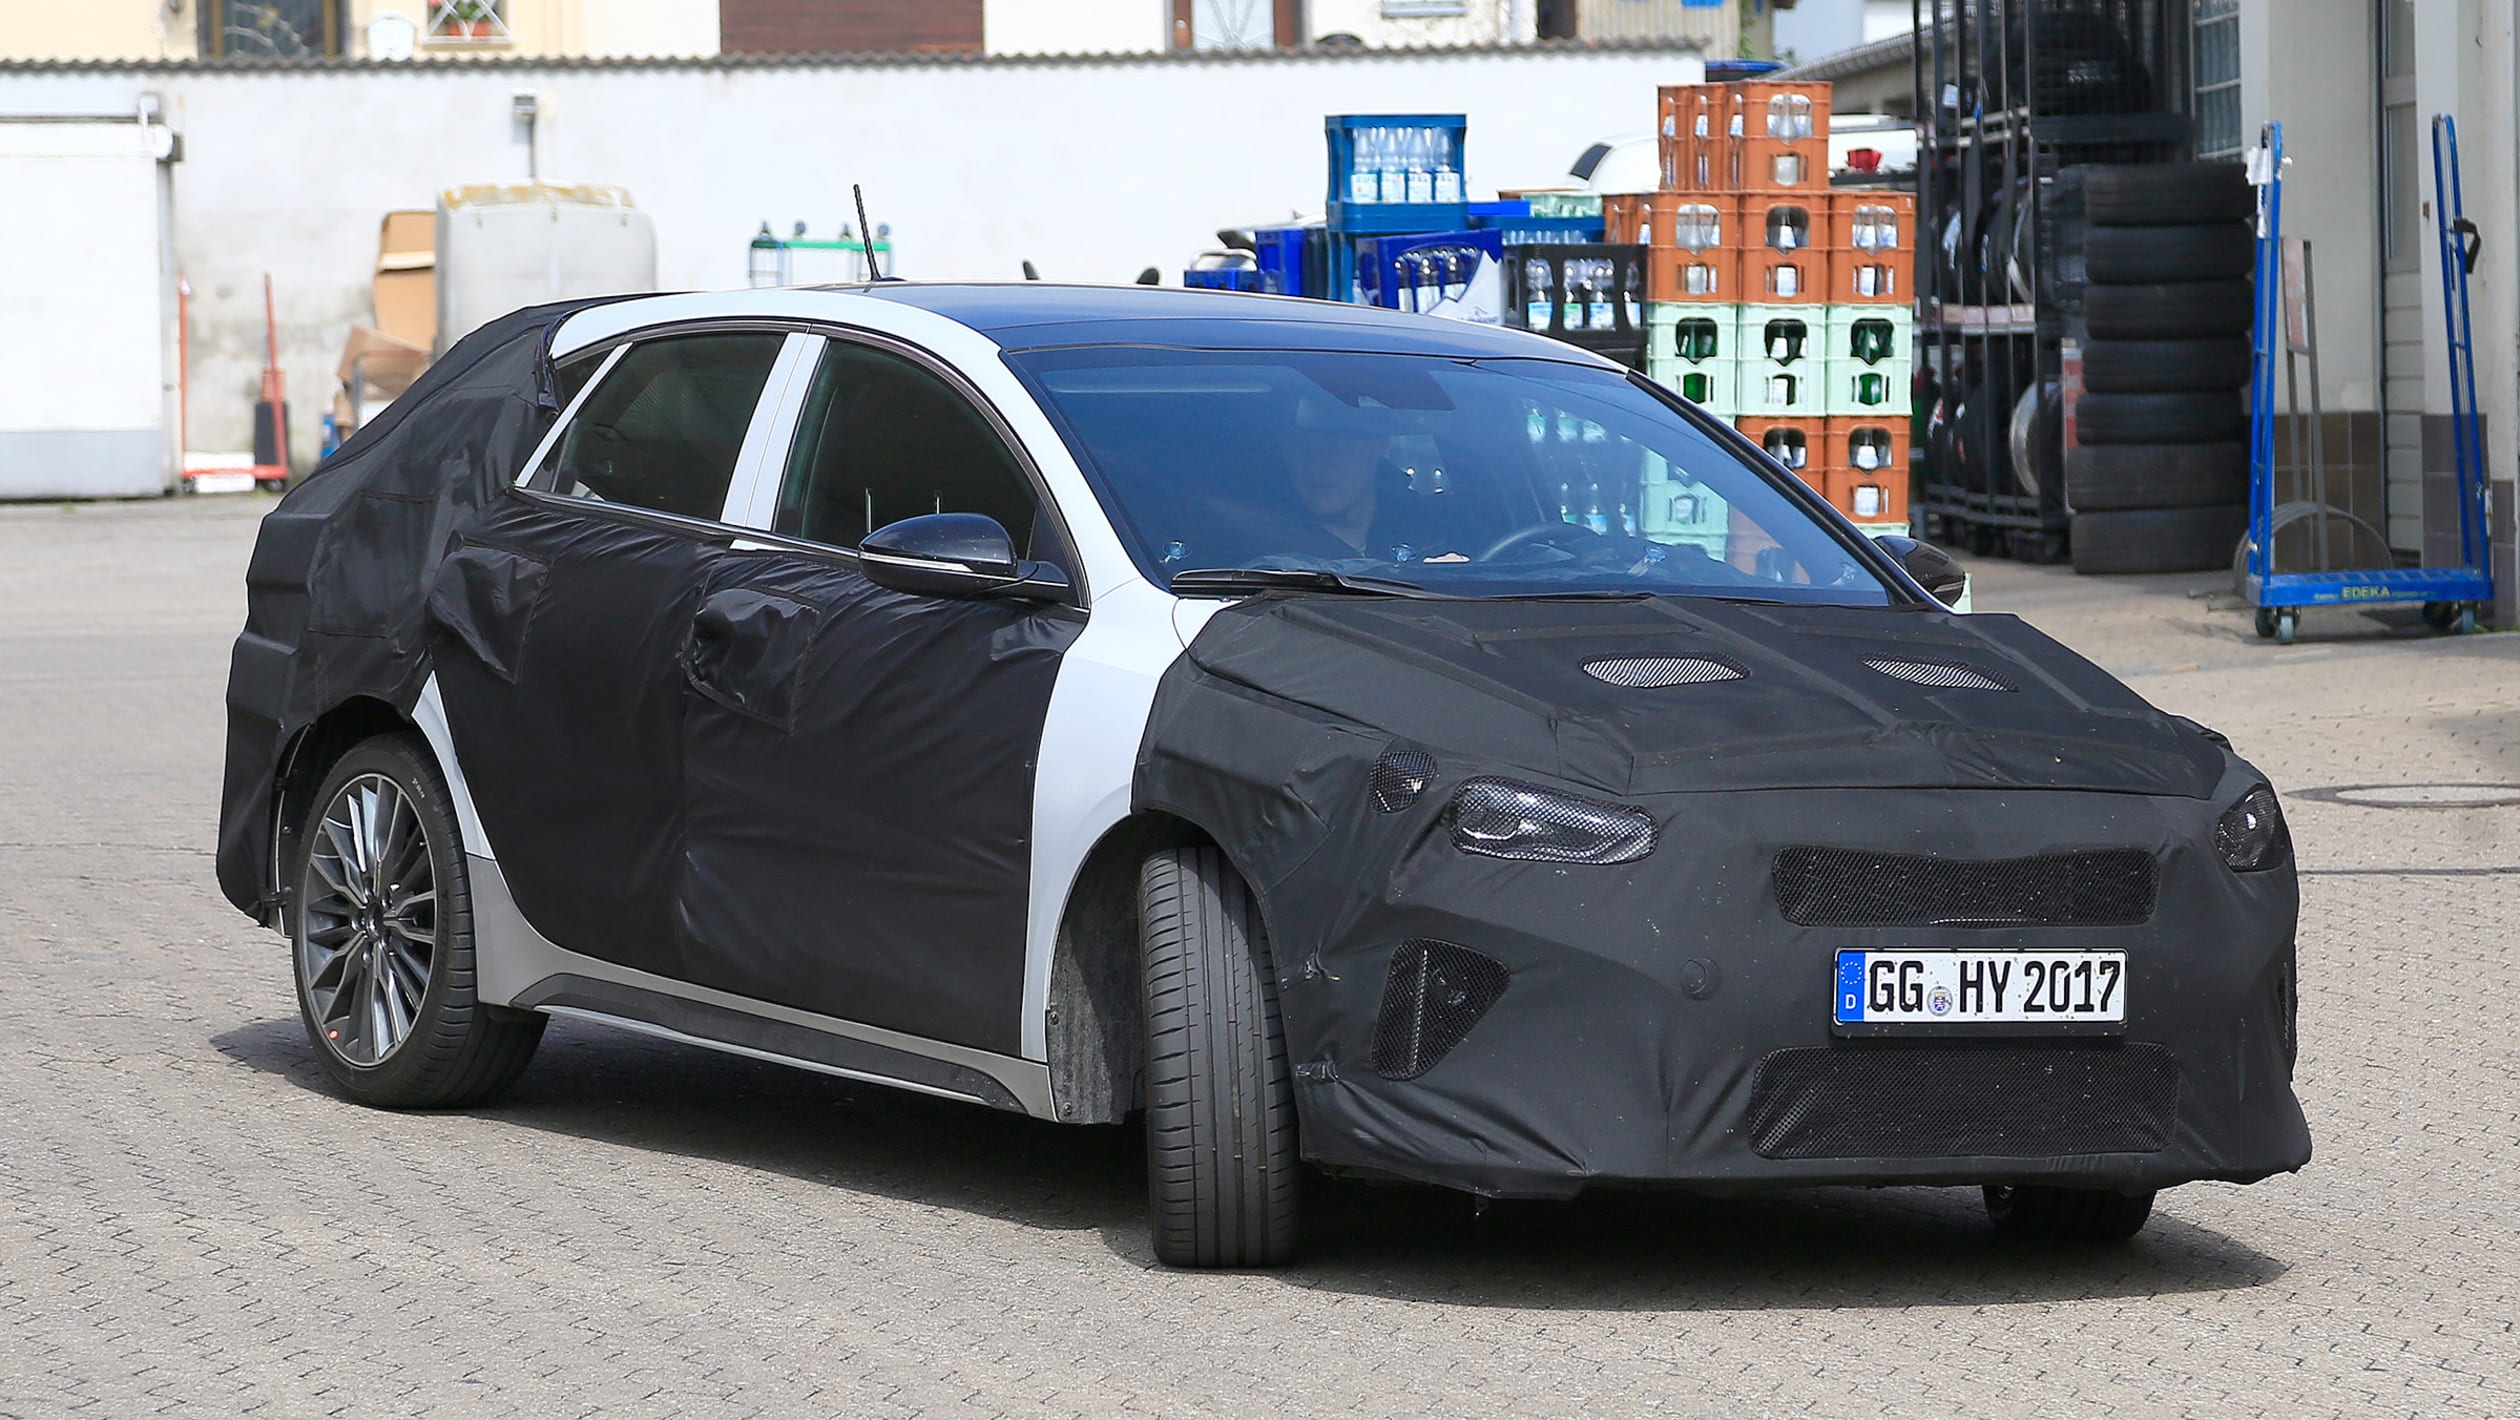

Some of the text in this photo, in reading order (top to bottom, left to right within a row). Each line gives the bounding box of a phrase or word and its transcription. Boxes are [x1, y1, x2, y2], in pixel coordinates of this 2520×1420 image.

[2342, 586, 2390, 599] EDEKA
[1870, 961, 2121, 1012] GG HY 2017
[1845, 994, 1857, 1009] D
